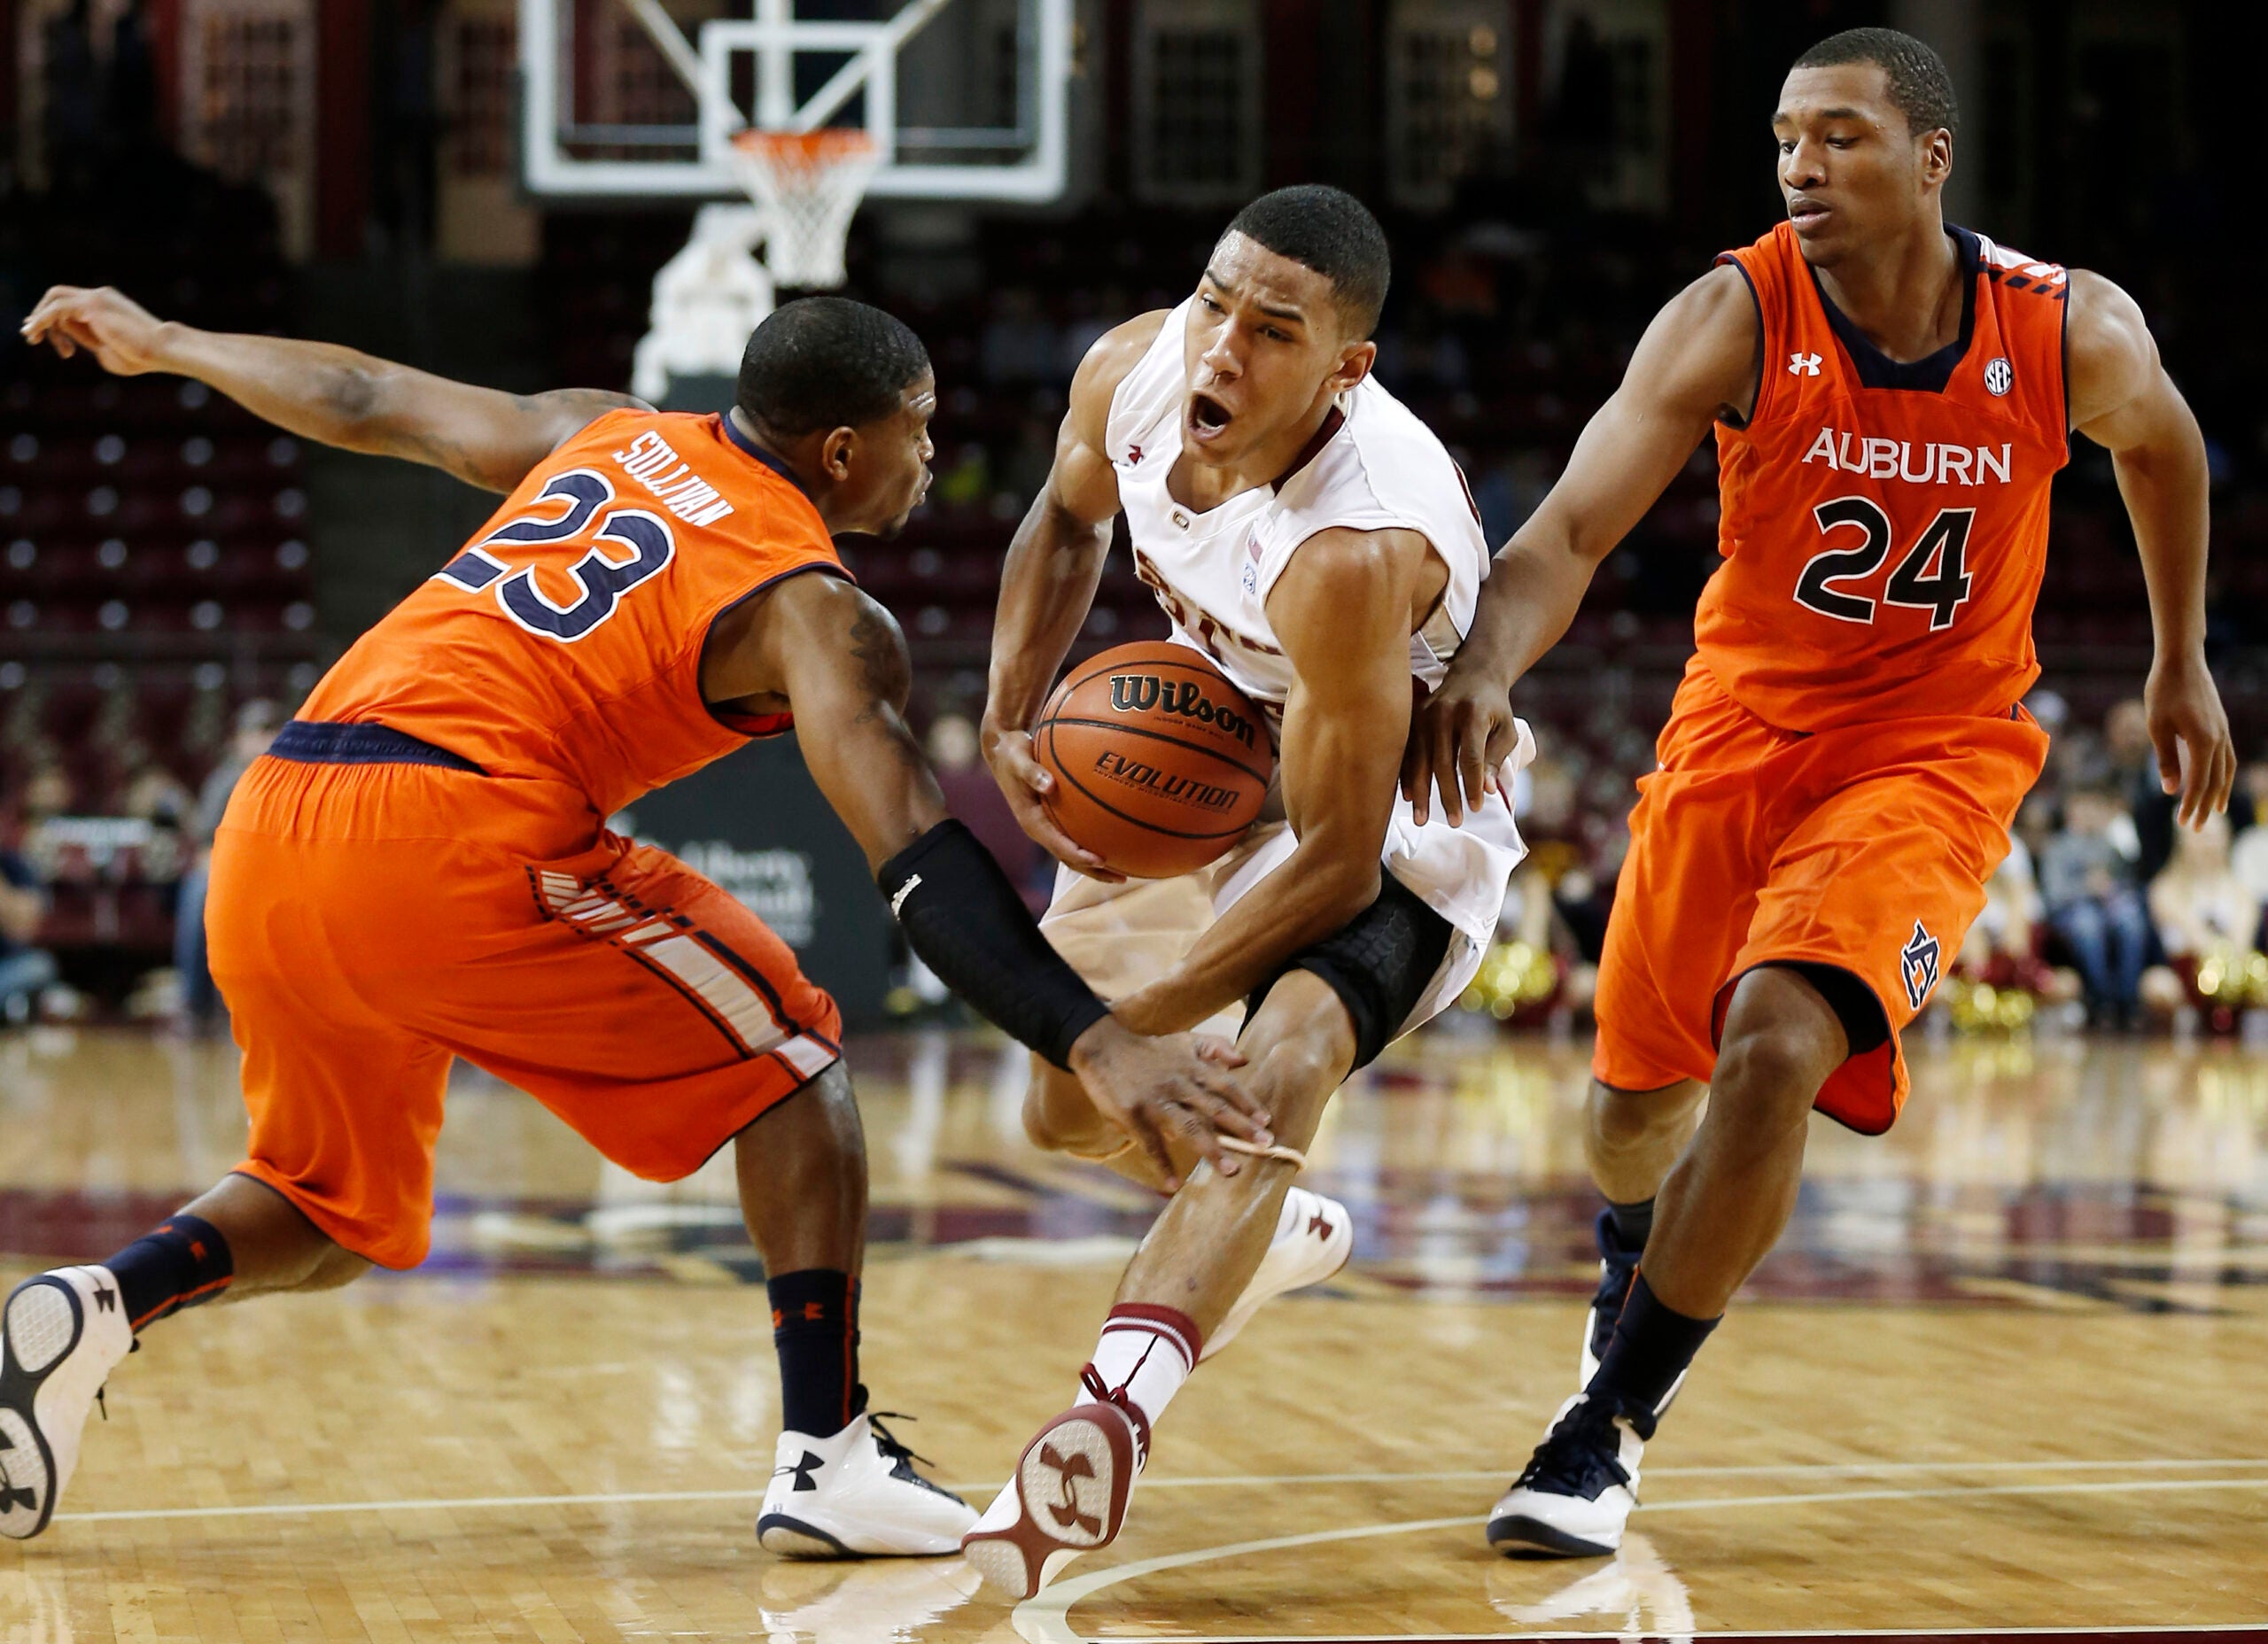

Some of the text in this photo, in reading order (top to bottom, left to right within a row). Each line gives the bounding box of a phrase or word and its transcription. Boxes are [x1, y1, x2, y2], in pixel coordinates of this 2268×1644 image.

[1985, 359, 2012, 395] SEC
[611, 430, 735, 527] SULLIVAN
[1801, 427, 2012, 486] AUBURN
[429, 468, 676, 643] 23
[1792, 495, 1977, 632] 24
[1110, 674, 1255, 750] Wilson
[1096, 751, 1240, 810] EVOLUTION
